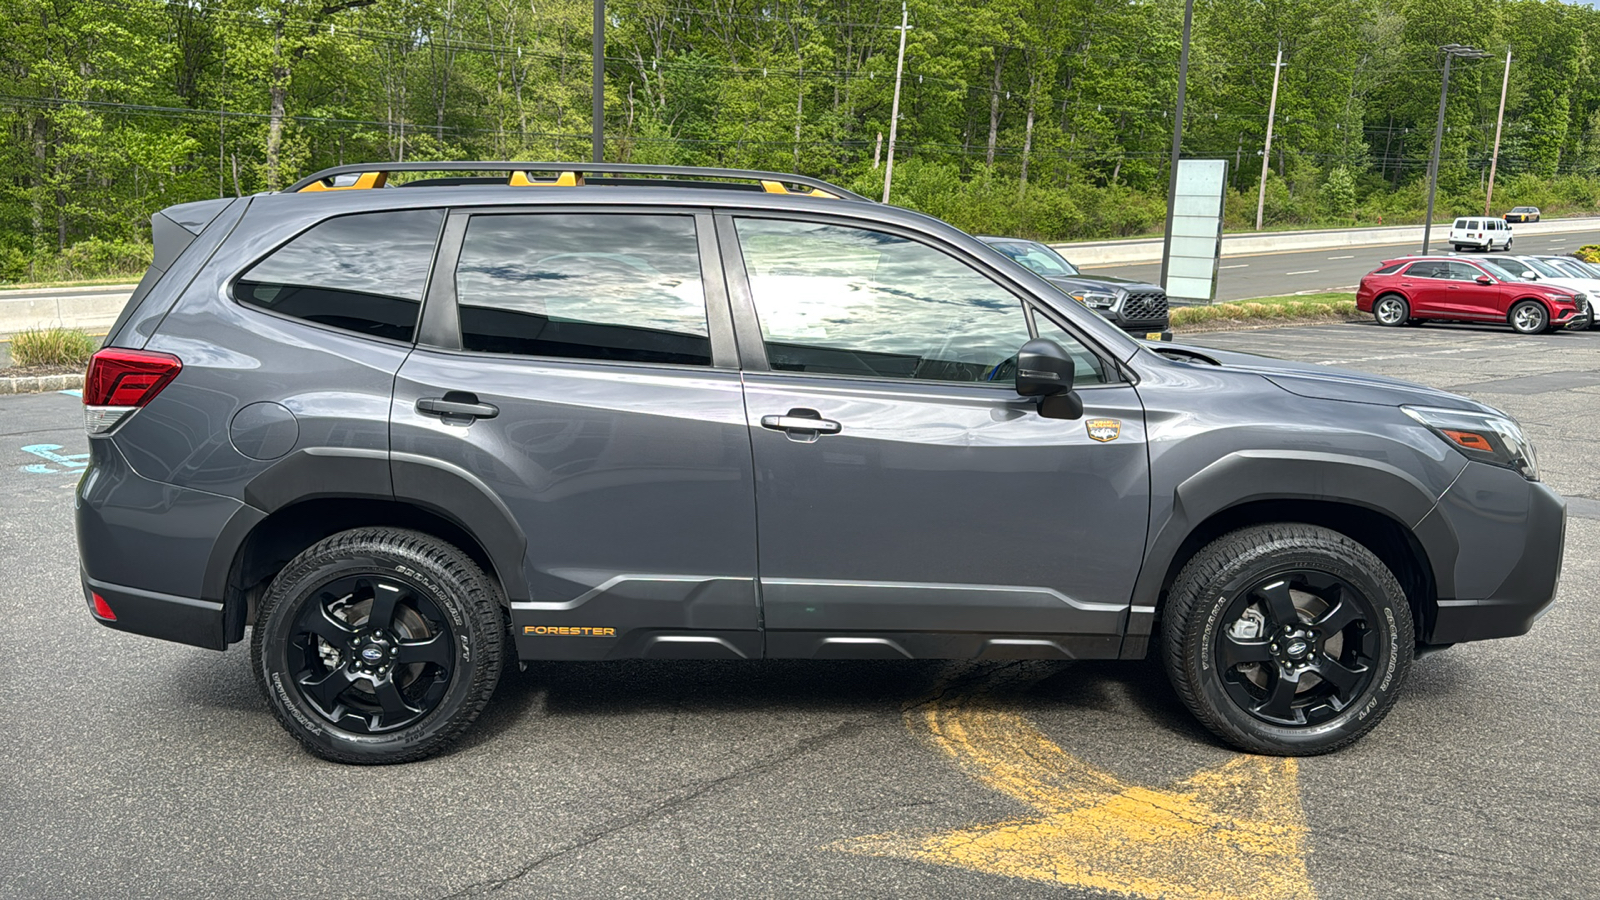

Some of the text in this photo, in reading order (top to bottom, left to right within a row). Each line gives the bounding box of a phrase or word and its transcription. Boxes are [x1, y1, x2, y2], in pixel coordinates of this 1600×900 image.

[524, 625, 616, 636] FORESTER
[1201, 596, 1226, 670] YOKOHAMA
[1380, 607, 1399, 692] GEOLANDAR
[271, 671, 322, 737] YOKOHAMA
